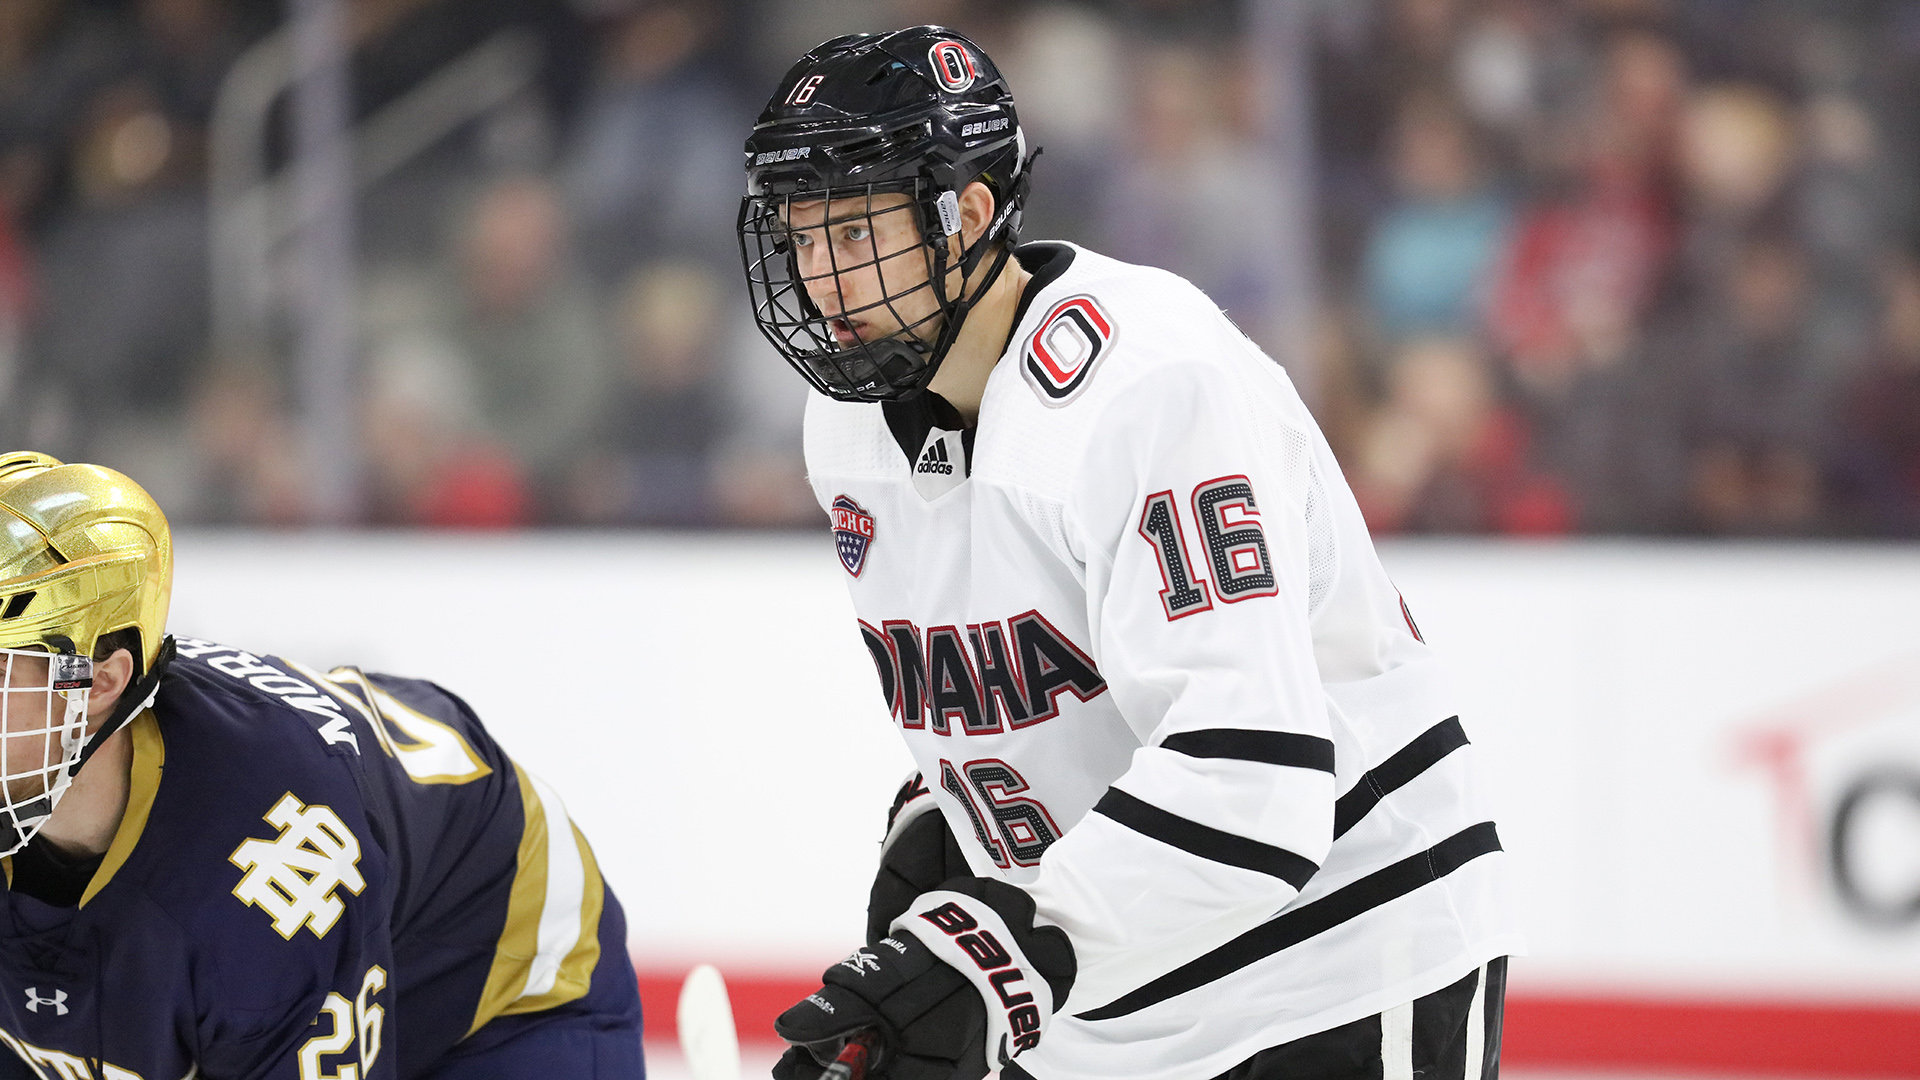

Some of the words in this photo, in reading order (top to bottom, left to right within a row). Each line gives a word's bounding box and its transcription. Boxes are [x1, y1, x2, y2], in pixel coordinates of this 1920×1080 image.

[784, 75, 825, 106] 16
[961, 118, 1009, 137] BAUER
[756, 147, 811, 166] BAUER
[917, 460, 953, 475] adidas
[1138, 474, 1279, 622] 16
[55, 681, 81, 689] CCM
[164, 633, 361, 756] MORR
[228, 791, 367, 940] ND
[939, 758, 1064, 869] 16
[298, 965, 387, 1080] 26
[917, 902, 1041, 1060] BAUER
